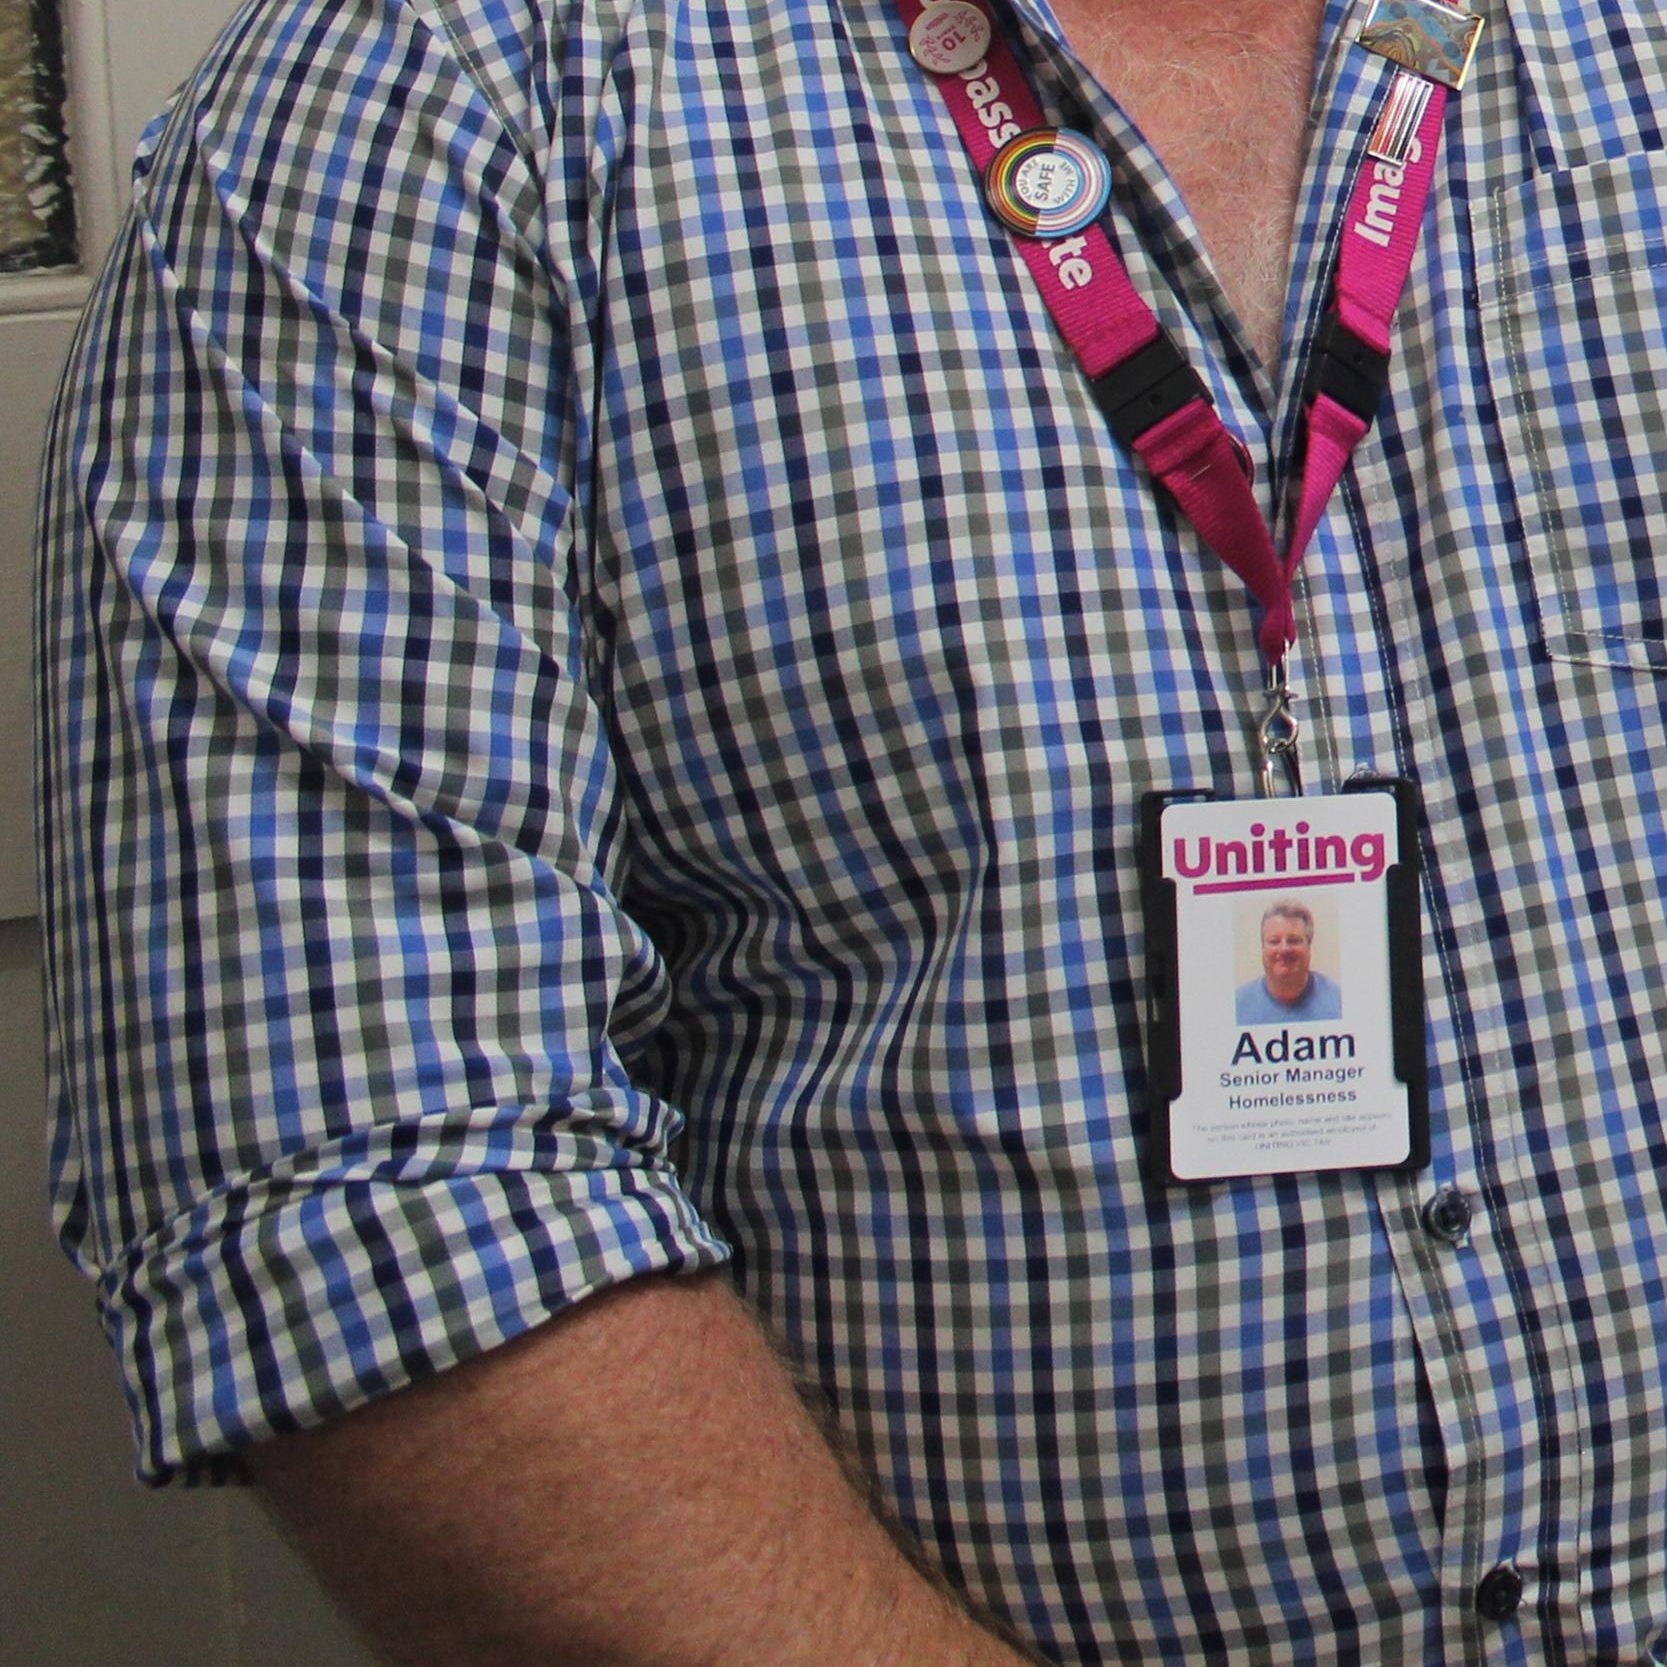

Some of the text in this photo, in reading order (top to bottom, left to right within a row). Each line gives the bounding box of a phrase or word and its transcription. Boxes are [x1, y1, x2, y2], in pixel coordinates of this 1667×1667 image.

[1035, 162, 1057, 202] SAFE
[1173, 820, 1387, 883] Uniting
[1231, 1029, 1356, 1067] Adam
[1219, 1065, 1366, 1088] Senior Manager
[1229, 1090, 1357, 1110] Homelessness
